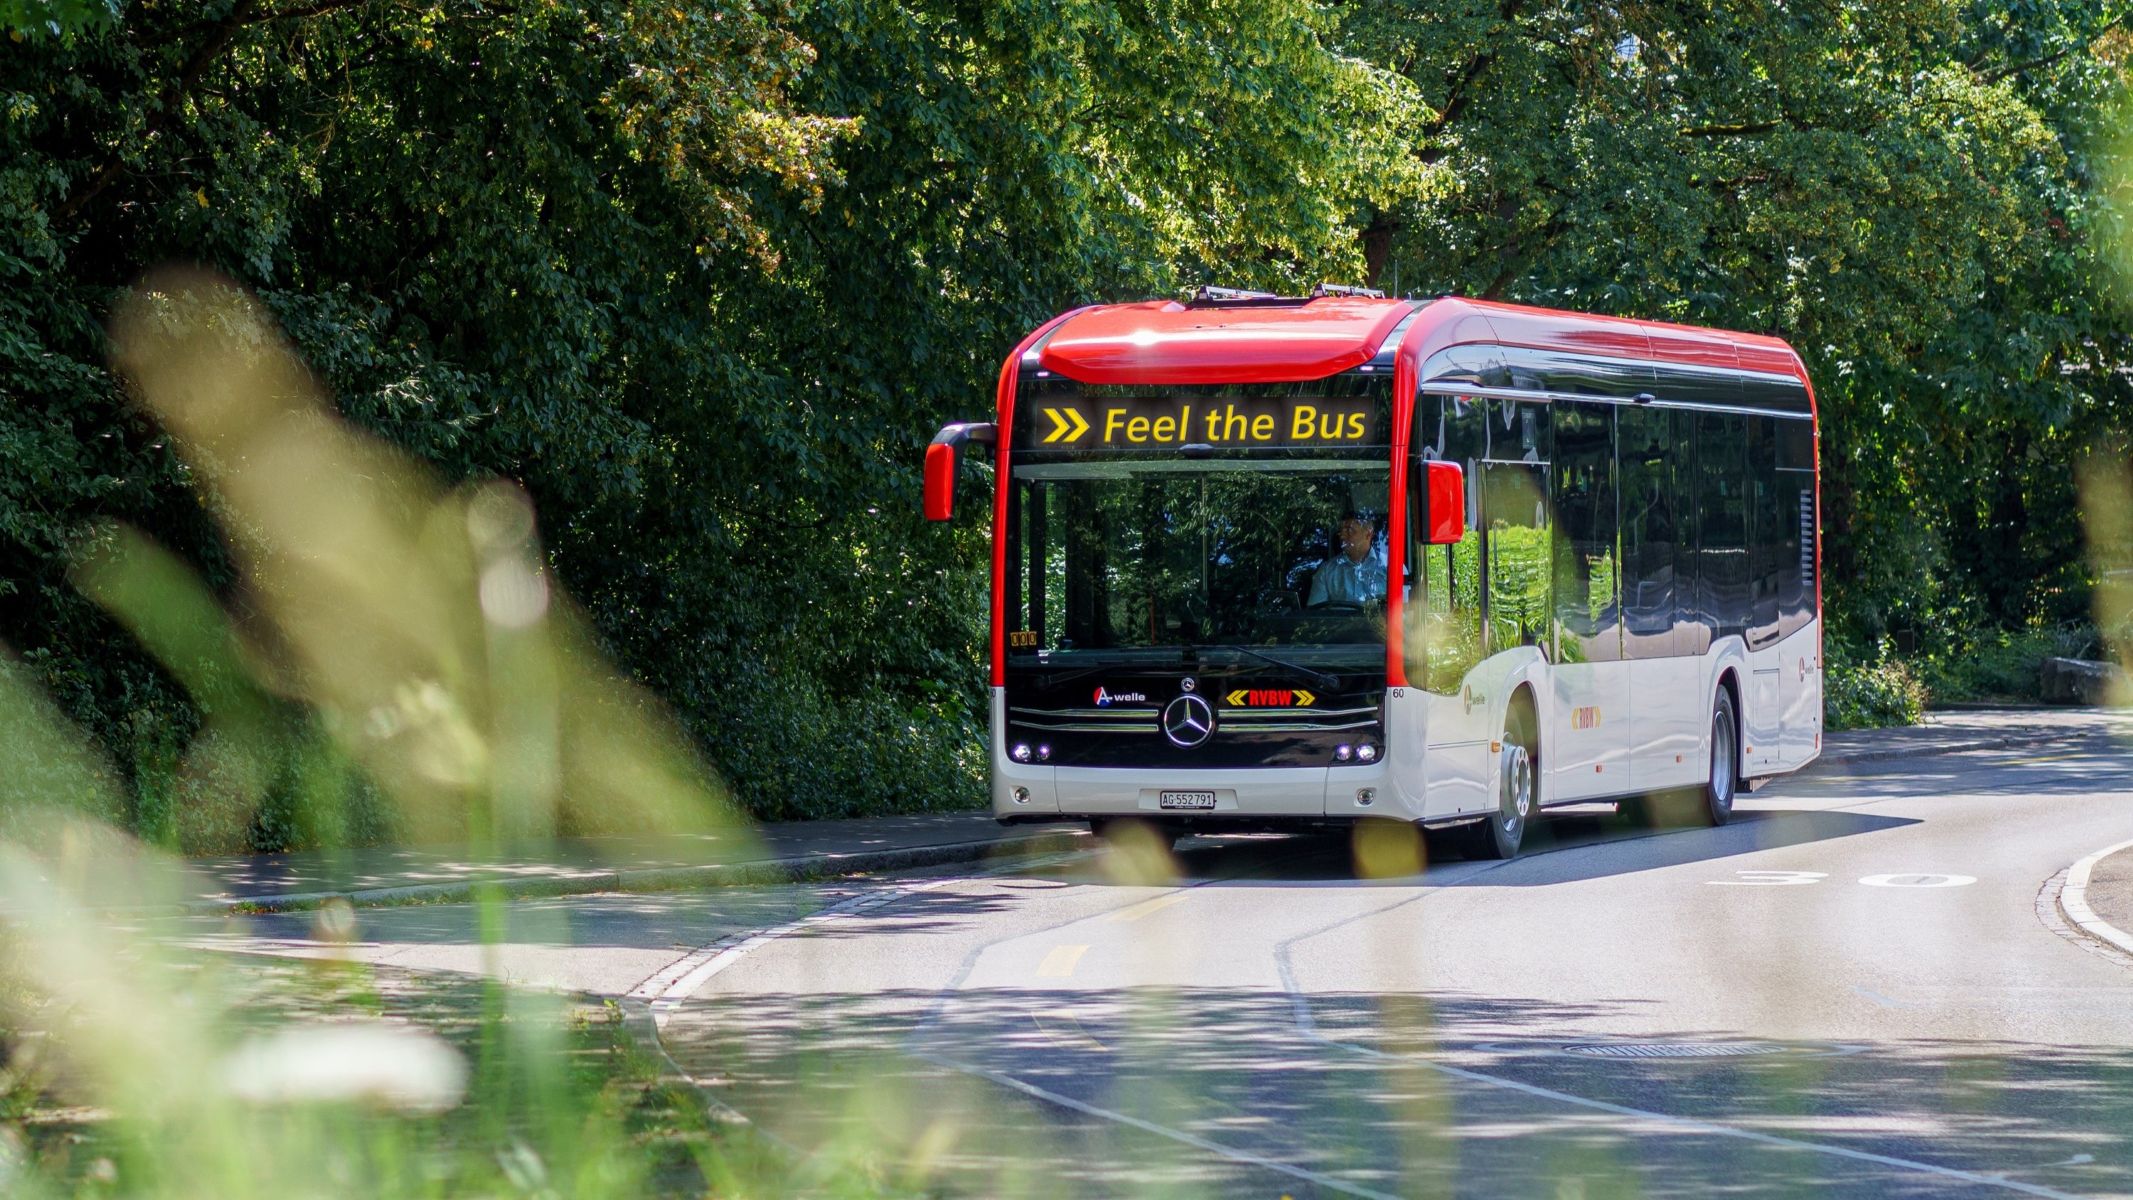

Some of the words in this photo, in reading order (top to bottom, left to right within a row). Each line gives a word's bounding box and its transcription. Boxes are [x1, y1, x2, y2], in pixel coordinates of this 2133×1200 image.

[1104, 405, 1190, 442] Feel
[1205, 404, 1275, 441] the
[1291, 404, 1366, 440] Bus
[1249, 689, 1292, 706] RVBW
[1392, 688, 1404, 698] 60
